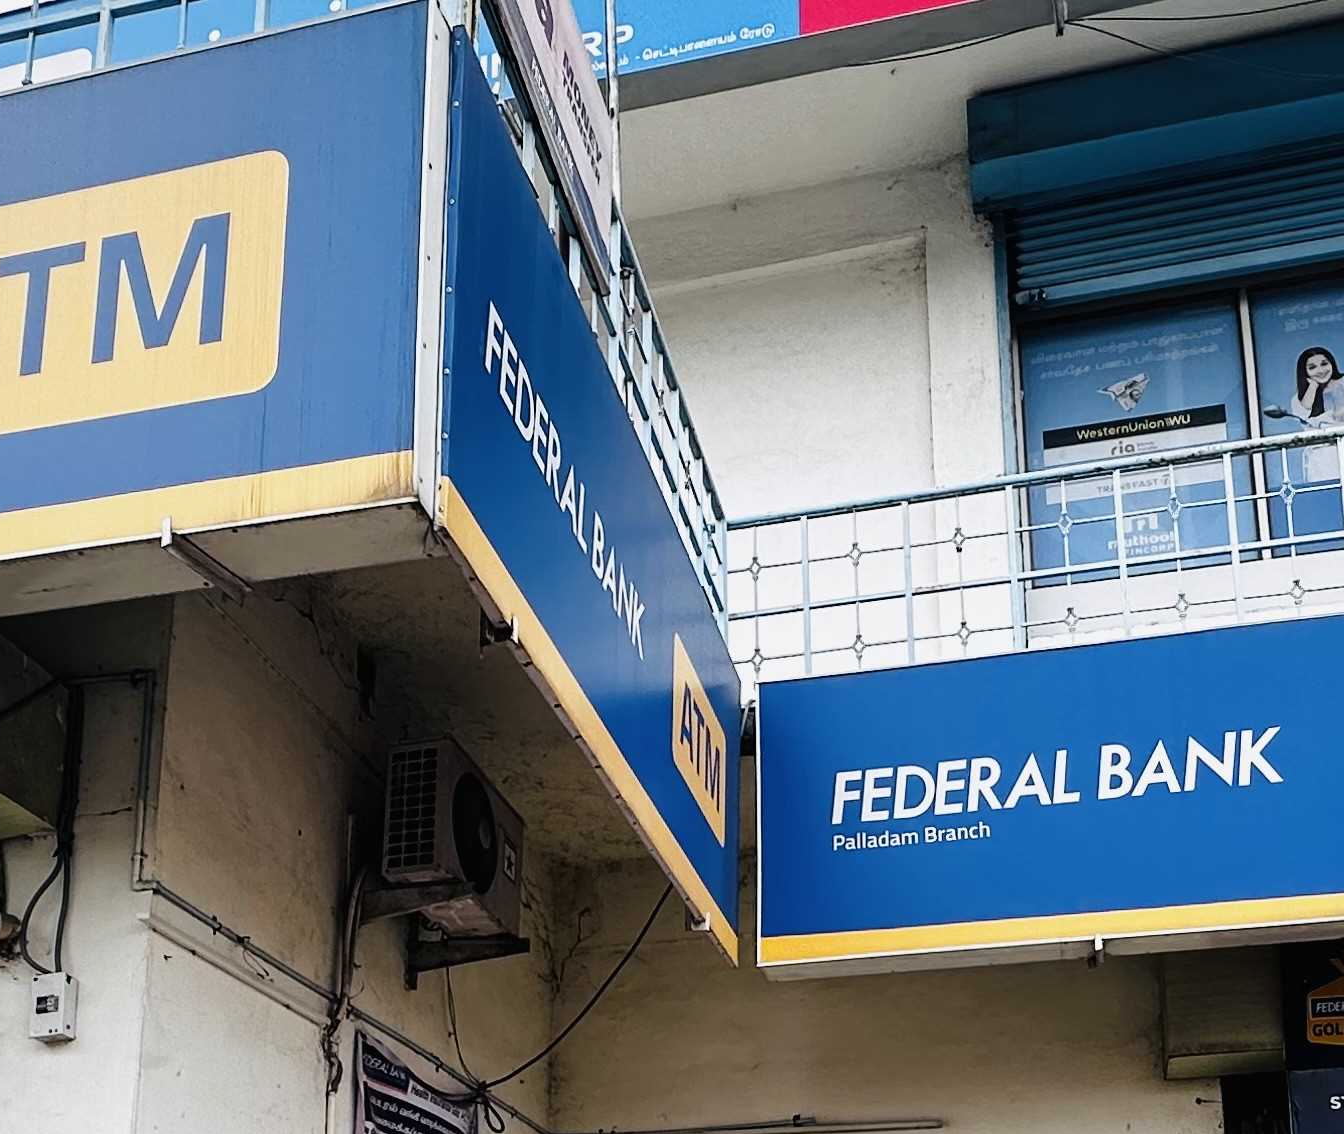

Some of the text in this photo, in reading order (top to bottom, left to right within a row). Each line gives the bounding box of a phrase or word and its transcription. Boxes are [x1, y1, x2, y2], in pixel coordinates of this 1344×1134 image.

[484, 300, 646, 661] FEDERAL BANK
[1111, 441, 1135, 455] ria
[679, 680, 723, 814] ATM
[831, 726, 1285, 825] FEDERAL BANK
[832, 822, 990, 852] Palladam Branch
